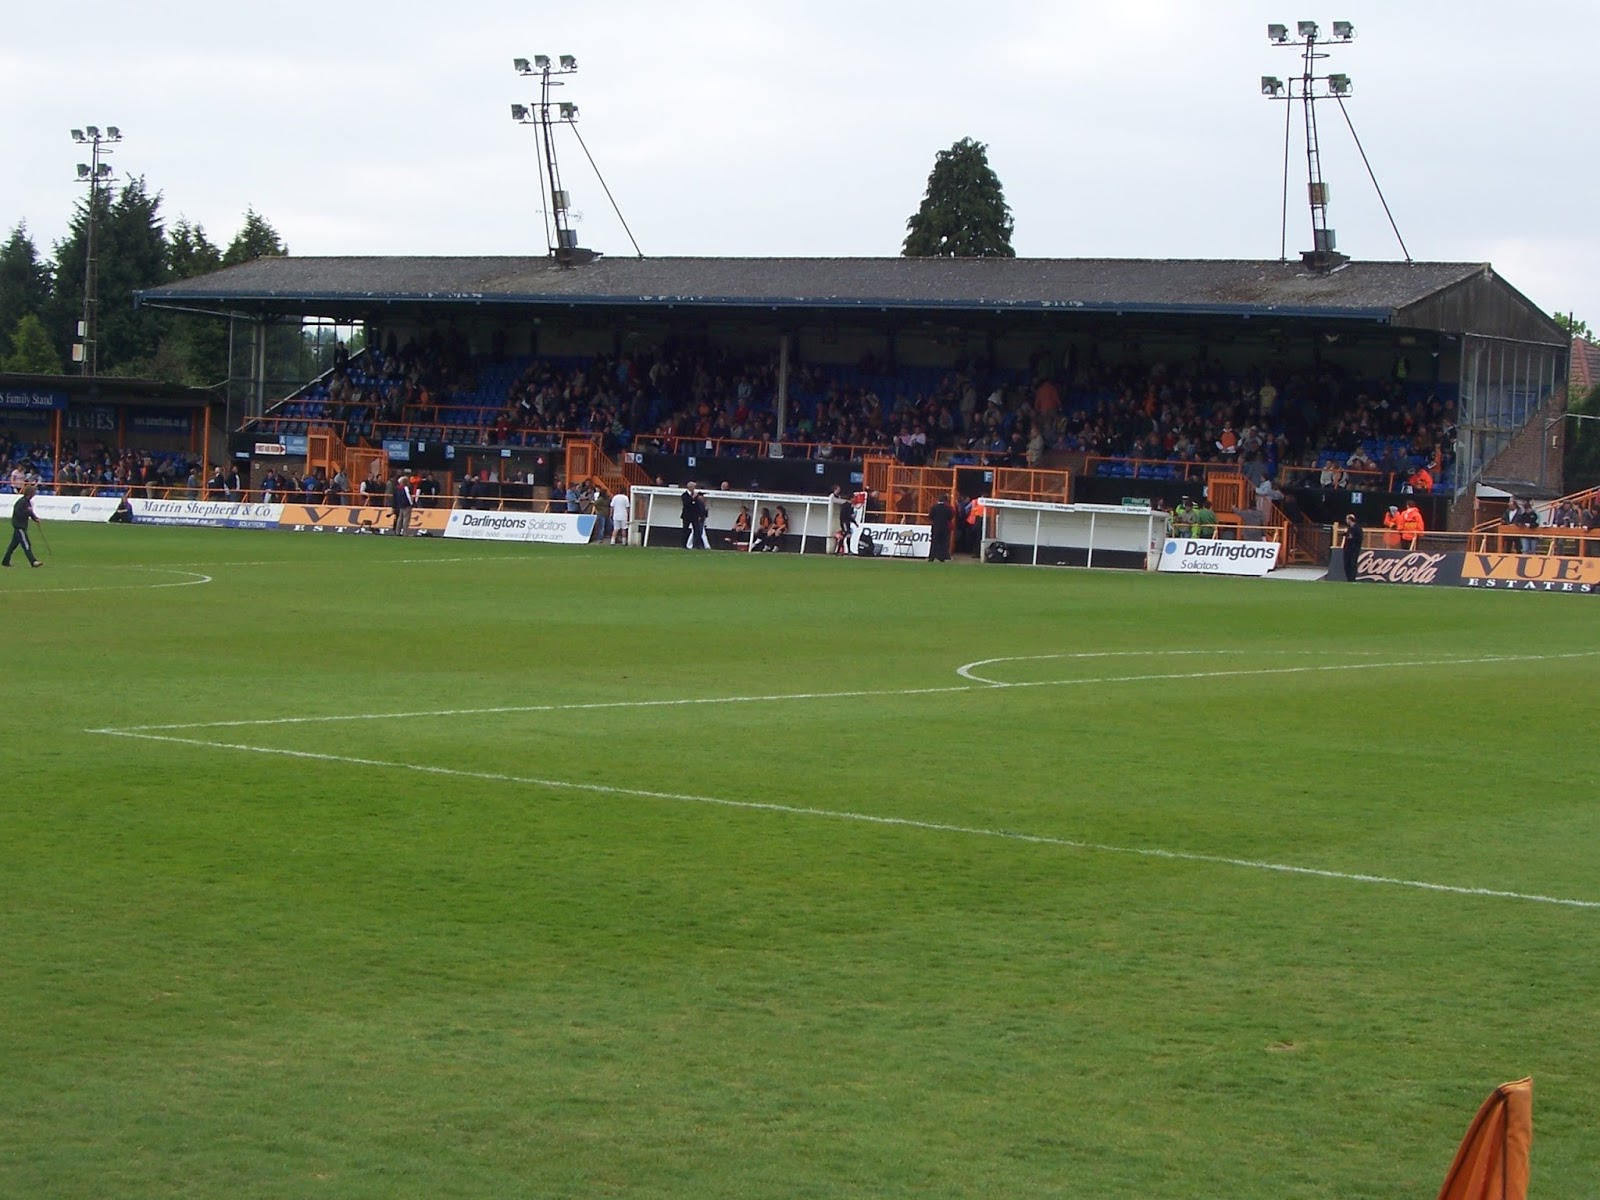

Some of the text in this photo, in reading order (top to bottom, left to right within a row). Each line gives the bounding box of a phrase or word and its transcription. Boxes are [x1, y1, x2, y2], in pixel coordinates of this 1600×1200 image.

[6, 392, 30, 407] Family
[32, 393, 53, 405] Stand
[688, 457, 695, 466] D
[816, 464, 824, 473] E
[985, 471, 992, 482] F
[1352, 493, 1362, 503] H
[141, 500, 272, 518] Martin Shepherd & Co.
[462, 514, 567, 531] Darlingtons Solicitors
[293, 524, 430, 536] ESTATS
[862, 527, 932, 544] Darlington
[1184, 541, 1276, 560] Darlingtons
[1181, 559, 1219, 570] Solicitors
[1357, 551, 1447, 584] Coca-Cola
[1475, 554, 1584, 581] VUE
[1467, 578, 1592, 592] ESTATES
